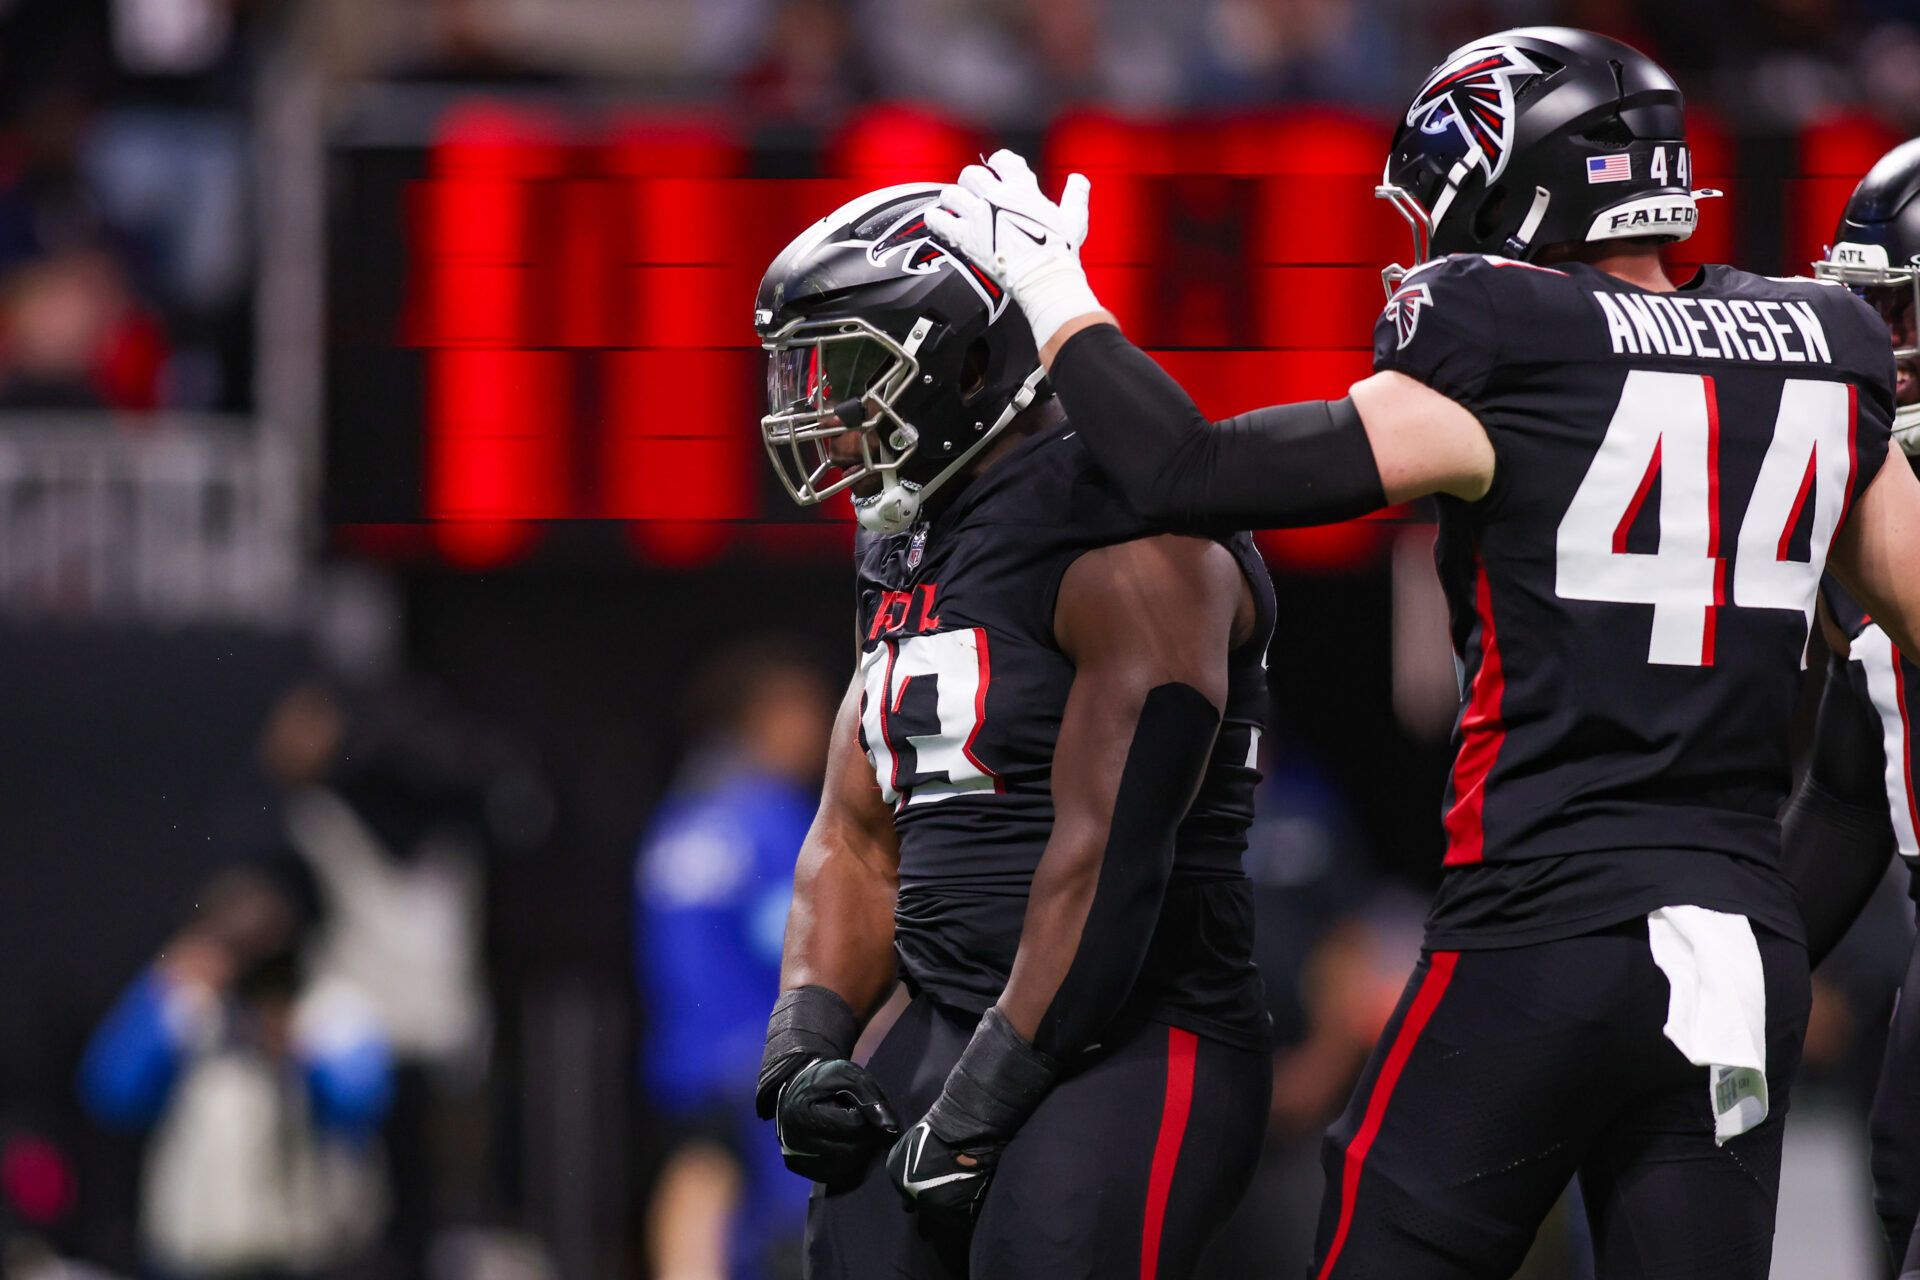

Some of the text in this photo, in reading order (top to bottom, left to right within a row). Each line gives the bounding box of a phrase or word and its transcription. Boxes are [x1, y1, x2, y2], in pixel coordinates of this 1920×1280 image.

[1650, 146, 1688, 187] 44
[1609, 206, 1697, 230] FALCO
[1839, 249, 1866, 263] ATL
[1593, 290, 1832, 364] ANDERSEN
[1555, 369, 1858, 671] 44
